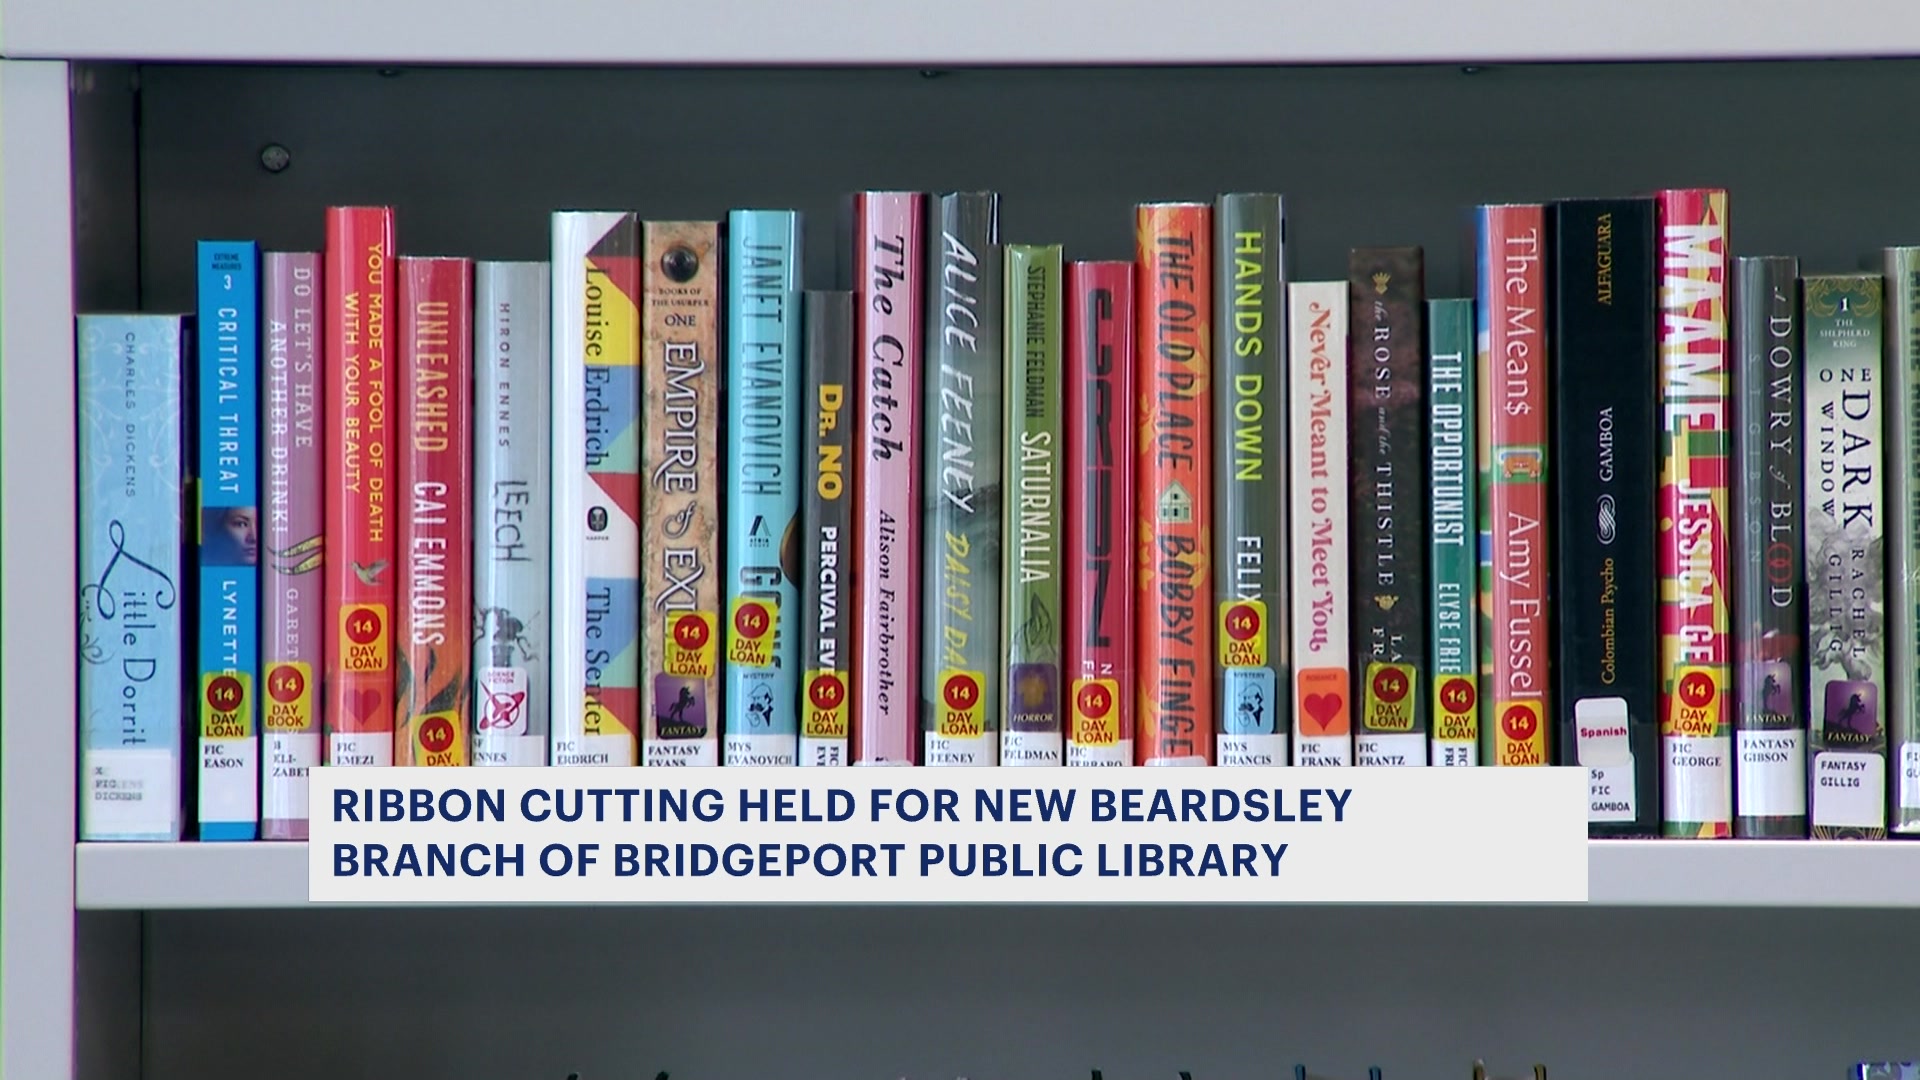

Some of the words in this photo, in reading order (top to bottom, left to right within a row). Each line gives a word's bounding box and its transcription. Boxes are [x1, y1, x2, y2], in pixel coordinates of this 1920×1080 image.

[223, 274, 232, 290] 3
[294, 267, 311, 296] DO
[368, 243, 383, 284] YOU
[690, 287, 701, 295] OF
[743, 237, 782, 322] JANET
[873, 235, 904, 316] The
[1157, 231, 1193, 293] THE
[1506, 228, 1538, 294] The
[1598, 213, 1613, 306] ALFAGUARA
[345, 293, 360, 345] WITH
[368, 293, 383, 349] MADE
[586, 267, 609, 357] Louise
[664, 313, 697, 327] ONE
[942, 231, 979, 353] ALICE
[1026, 265, 1045, 344] STEPHANIE
[1234, 232, 1263, 357] HANDS
[1374, 300, 1388, 321] the
[1841, 298, 1849, 312] 1
[218, 308, 238, 403] CRITICAL
[295, 307, 313, 372] LET'S
[499, 303, 510, 368] HIRON
[1157, 299, 1196, 363] OLD
[1309, 302, 1331, 387] Never
[1664, 224, 1722, 431] MAAME
[1820, 329, 1870, 337] SHEPHERD
[1833, 340, 1857, 348] KING
[125, 332, 135, 409] CHARLES
[270, 320, 288, 435] ANOTHER
[345, 354, 360, 407] YOUR
[368, 361, 382, 372] A
[414, 301, 448, 452] UNLEASHED
[1025, 348, 1045, 418] FELDMAN
[1374, 327, 1391, 399] ROSE
[1432, 351, 1461, 392] THE
[1504, 304, 1537, 416] Mean$
[1769, 316, 1792, 454] DOWRY
[295, 384, 313, 448] HAVE
[368, 381, 383, 433] FOOL
[499, 382, 510, 448] ENNES
[585, 366, 609, 466] Erdrich
[653, 338, 705, 494] EMPIRE
[742, 343, 782, 494] EVANOVICH
[818, 384, 843, 437] DR.
[872, 333, 904, 462] Catch
[1157, 370, 1194, 472] PLACE
[1234, 375, 1263, 481] DOWN
[125, 424, 136, 498] DICKENS
[219, 413, 239, 494] THREAT
[345, 418, 361, 493] BEAUTY
[368, 442, 383, 468] OF
[941, 363, 974, 513] FEENEY
[1309, 388, 1332, 479] Meant
[1600, 406, 1614, 482] GAMBOA
[1821, 401, 1835, 518] WINDOW
[1842, 390, 1872, 528] DARK
[271, 447, 289, 534] DRINK!
[413, 481, 447, 525] CAI
[817, 445, 843, 500] NO
[1311, 488, 1328, 514] to
[1432, 403, 1463, 546] OPPORTUNIST
[369, 477, 383, 542] DEATH
[494, 480, 532, 563] LEECH
[662, 501, 696, 538] of
[1019, 431, 1051, 583] SATURNALIA
[1376, 462, 1393, 584] THISTLE
[879, 510, 896, 580] Alison
[944, 530, 974, 622] DAISY
[1236, 536, 1261, 602] FELIX
[1311, 518, 1332, 588] Meet
[1500, 511, 1540, 586] Amy
[1677, 481, 1714, 610] JESSICA
[1766, 501, 1793, 608] BLOOD
[412, 537, 447, 646] EMMONS
[655, 546, 705, 612] EXI
[819, 526, 838, 633] PERCIVAL
[1157, 534, 1195, 646] BOBBY
[1439, 583, 1460, 629] ELYSE
[1601, 557, 1617, 604] Psycho
[1828, 554, 1842, 652] GILLIG
[1852, 549, 1866, 658] RACHEL
[223, 579, 237, 677] LYNETTE
[286, 588, 299, 658] GARET
[353, 620, 373, 633] 14
[586, 586, 611, 639] The
[1309, 590, 1334, 652] You
[345, 658, 382, 669] LOAN
[350, 646, 376, 657] DAY
[879, 588, 895, 715] Fairbrother
[1440, 637, 1461, 673] FRIE
[1509, 598, 1543, 697] Fussel
[1601, 607, 1614, 685] Colombian
[123, 658, 156, 745] Dorrit
[272, 705, 298, 715] DAY
[275, 678, 297, 691] 14
[1085, 694, 1103, 708] 14
[1159, 658, 1196, 757] FINGE
[267, 716, 304, 727] BOOK
[659, 725, 705, 735] FANTASY
[1013, 713, 1053, 722] HORROR
[1077, 732, 1113, 743] LOAN
[1082, 721, 1107, 732] DAY
[1301, 743, 1321, 753] FIC
[1359, 743, 1378, 753] FIC
[1580, 726, 1627, 738] Spanish
[1672, 743, 1691, 753] FIC
[1744, 739, 1796, 750] FANTASY
[1828, 732, 1869, 743] FANTASY
[204, 759, 243, 768] EASON
[337, 756, 374, 765] EMEZI
[556, 754, 609, 765] ERDRICH
[648, 745, 700, 755] FANTASY
[728, 754, 792, 765] EVANOVICH
[1004, 749, 1058, 760] FELDMAN
[1223, 755, 1272, 764] FRANCIS
[1301, 757, 1341, 767] FRANK
[1359, 755, 1405, 765] FRANTZ
[1591, 769, 1604, 780] Sp
[1672, 756, 1722, 766] GEORGE
[1744, 751, 1788, 762] GIBSON
[1821, 761, 1865, 770] FANTASY
[1821, 777, 1860, 787] GILLIG
[1591, 786, 1610, 795] FIC
[1591, 802, 1630, 811] GAMBOA
